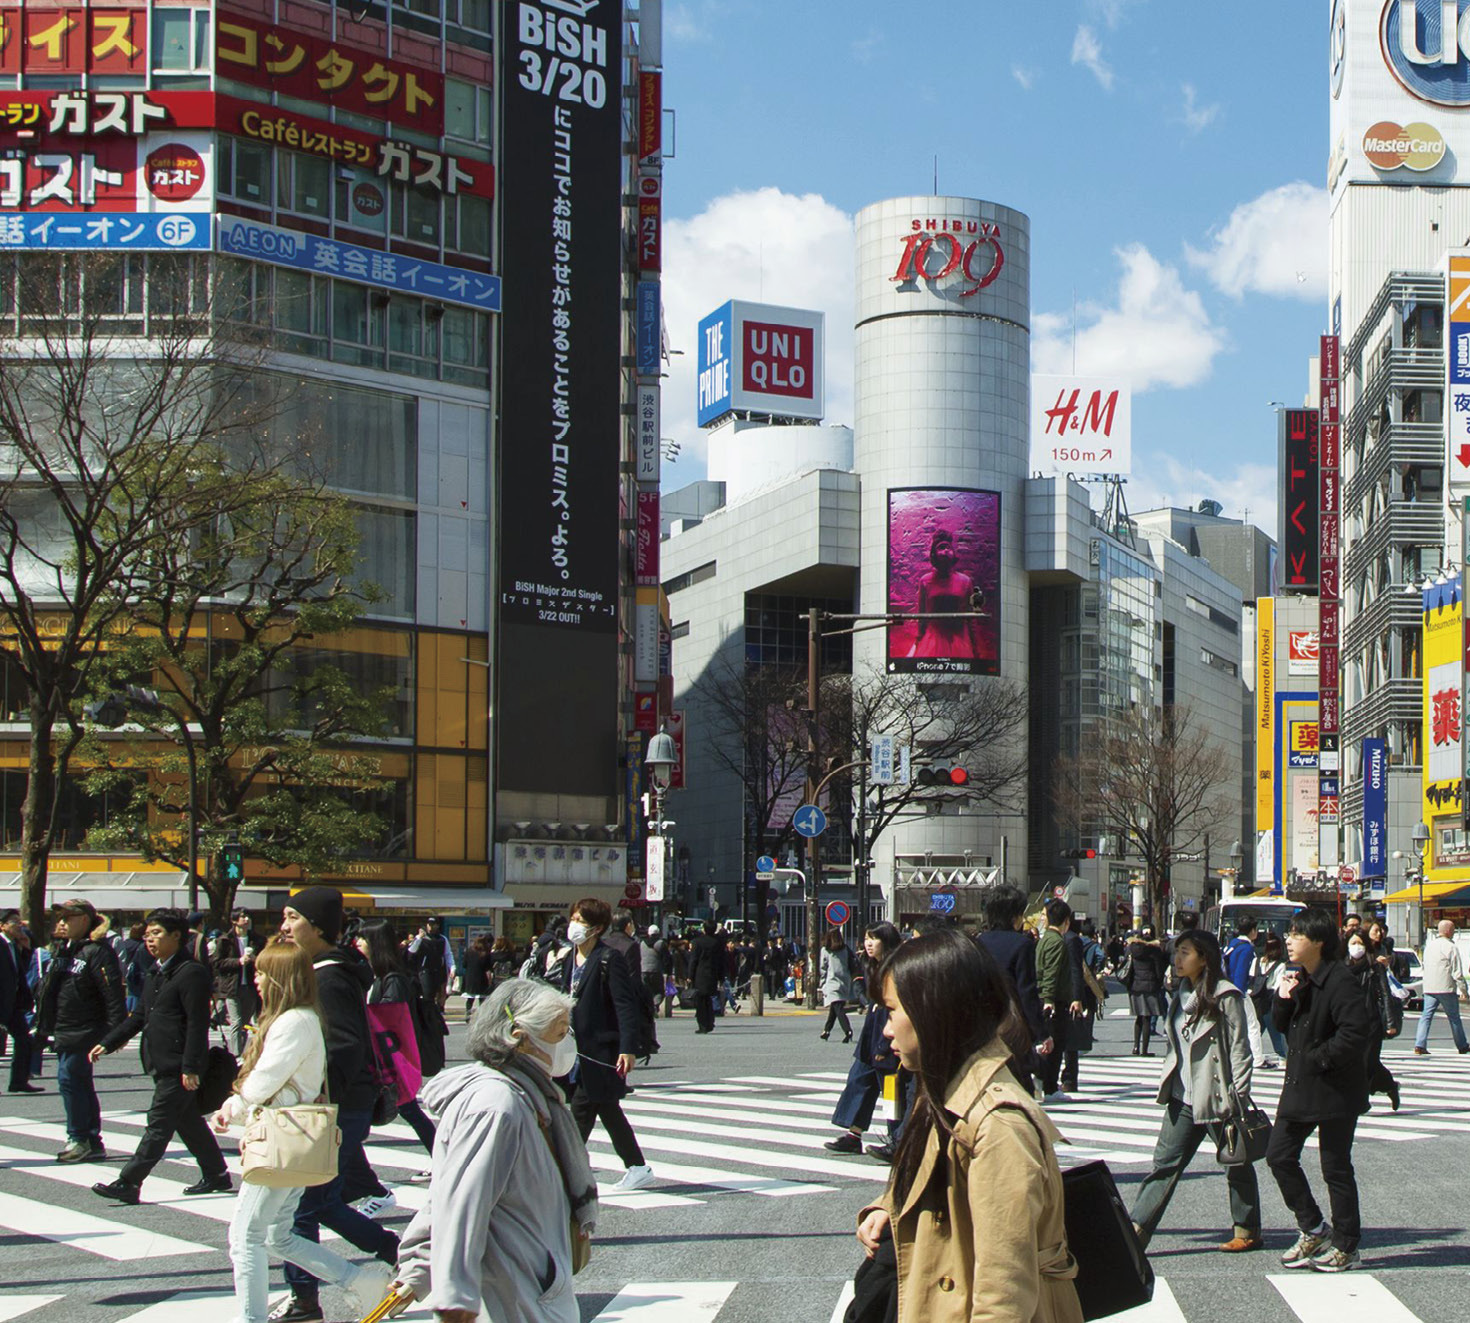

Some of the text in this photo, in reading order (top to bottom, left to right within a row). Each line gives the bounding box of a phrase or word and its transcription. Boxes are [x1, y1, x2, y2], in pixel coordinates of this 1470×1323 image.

[0, 16, 138, 57] イス
[519, 2, 606, 67] BiSH
[218, 21, 434, 114] コンタクト
[519, 50, 606, 109] 3/20
[0, 93, 165, 133] ラン ガスト
[1364, 138, 1443, 154] MasterCard
[153, 169, 200, 184] ガスト
[379, 142, 473, 193] ガスト
[162, 221, 190, 240] 6F
[643, 217, 656, 260] ガスト
[911, 219, 1002, 237] SHIBUYA
[230, 224, 495, 299] AEON 英会話イーオン
[889, 232, 1005, 298] 109
[705, 321, 723, 360] THE
[751, 329, 801, 361] UNI
[1458, 336, 1468, 366] BOOK
[699, 358, 729, 411] PRIME
[751, 360, 805, 389] QLO
[1045, 388, 1119, 437] H&M
[642, 394, 655, 473] 渋谷駅前ビル
[515, 581, 603, 601] BiSH Major 2nd Single
[539, 610, 580, 624] 3/22 OUT!!
[1261, 669, 1271, 729] Matsumoto
[1432, 688, 1460, 745] 薬
[1298, 724, 1318, 748] 薬
[881, 738, 891, 780] 渋谷駅前
[1372, 749, 1381, 789] MIZUHO
[1370, 821, 1378, 863] みずほ銀行
